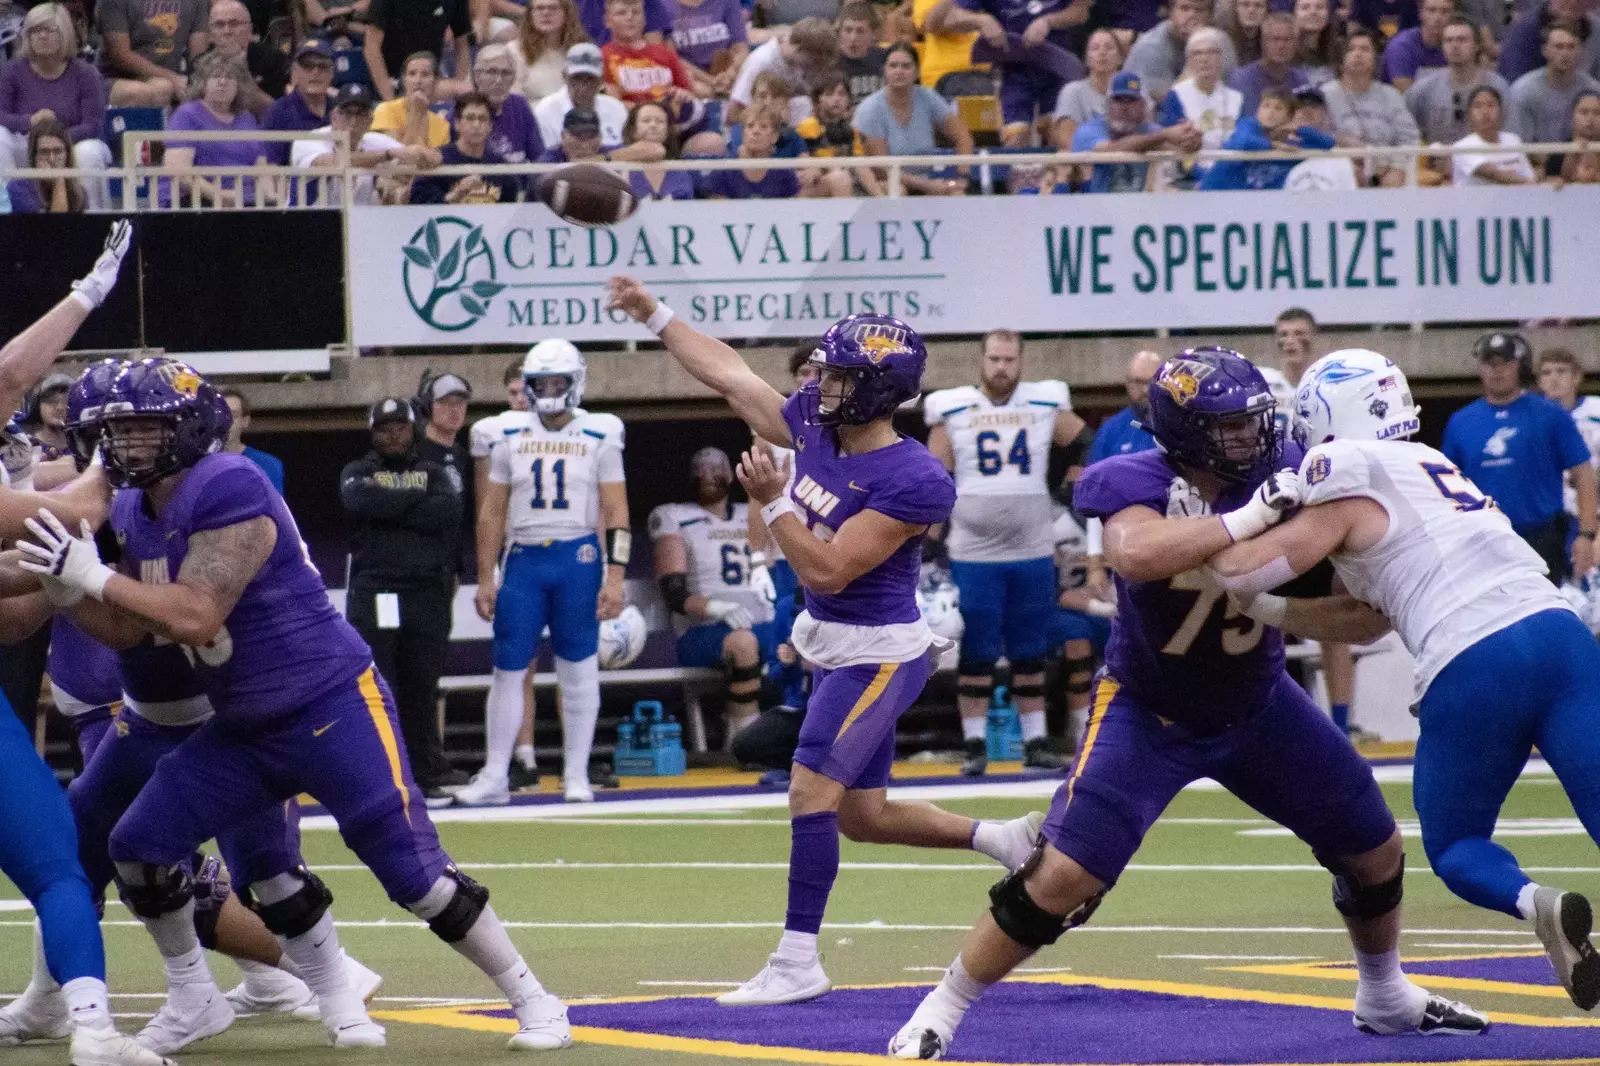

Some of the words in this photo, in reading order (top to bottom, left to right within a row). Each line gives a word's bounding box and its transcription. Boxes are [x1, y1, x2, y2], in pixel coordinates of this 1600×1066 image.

[504, 224, 701, 270] CEDAR
[722, 219, 942, 265] VALLEY
[1044, 225, 1115, 295] WE
[1132, 220, 1398, 293] SPECIALIZE
[1415, 218, 1459, 287] IN
[1477, 215, 1552, 286] UNI
[507, 295, 668, 327] MEDIC
[691, 291, 921, 322] SPECIALISTS
[517, 440, 588, 457] JACKRABBITS
[977, 427, 1031, 476] 64
[1376, 423, 1401, 440] LAST
[530, 457, 570, 509] 11
[794, 474, 841, 518] UNI
[720, 543, 751, 586] 6
